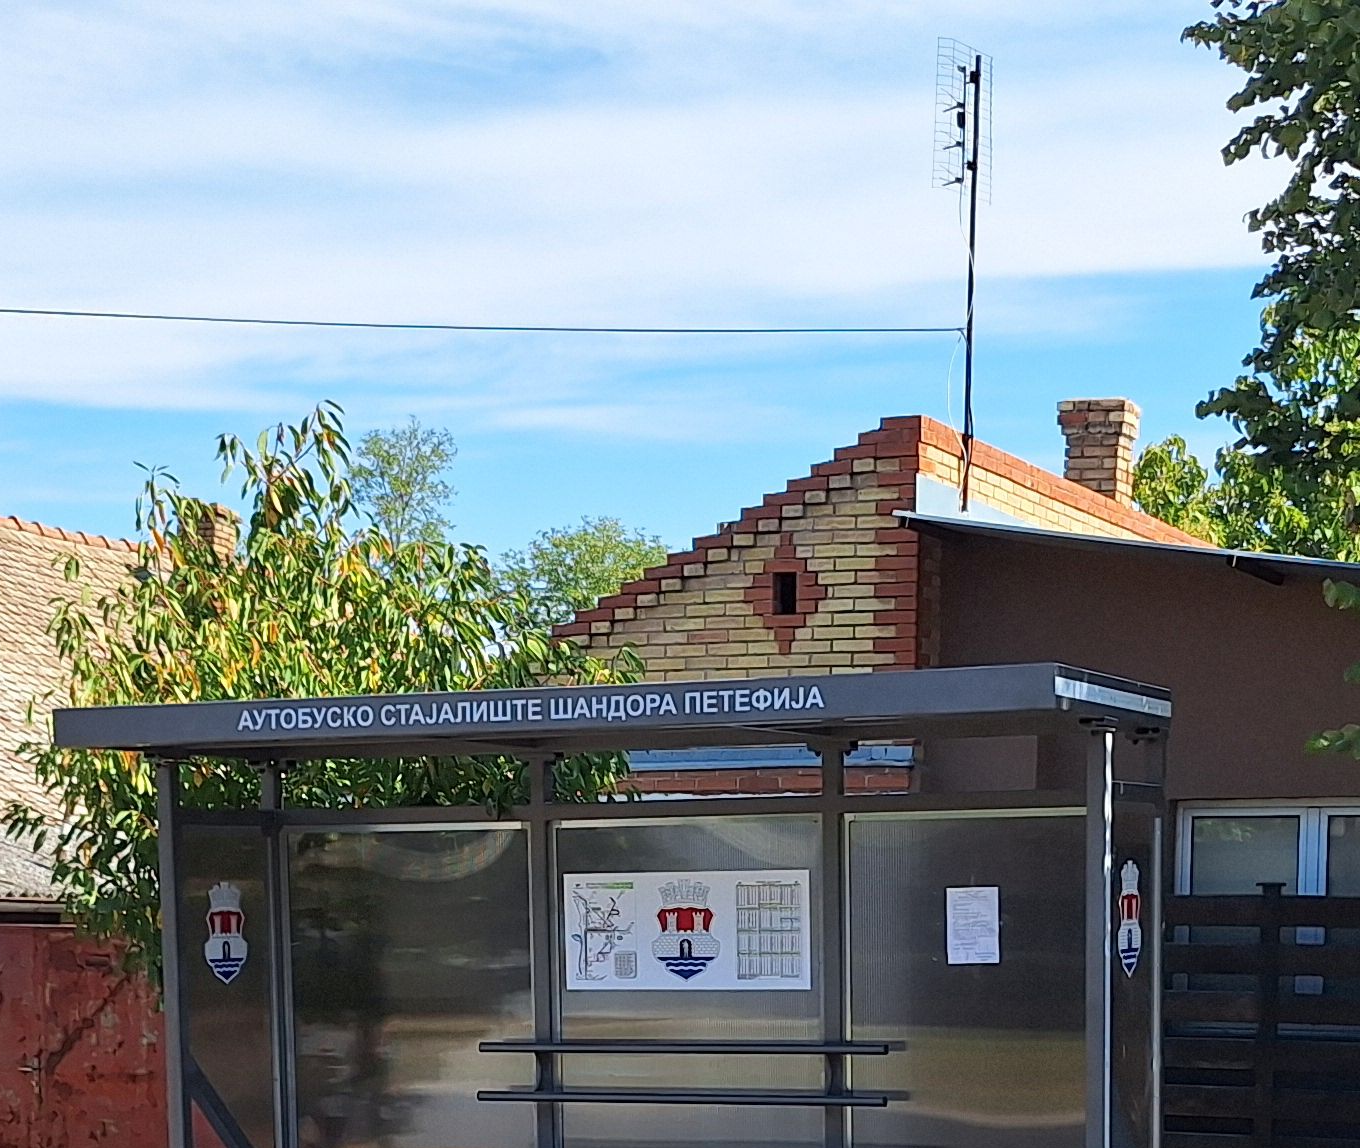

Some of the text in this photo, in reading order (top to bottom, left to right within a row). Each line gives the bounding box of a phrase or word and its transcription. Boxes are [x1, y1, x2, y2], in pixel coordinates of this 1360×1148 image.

[237, 686, 825, 731] АУТОБУСКО СТАЈАЛИШТЕ ШАНДОРА ПЕТЕФИЈА
